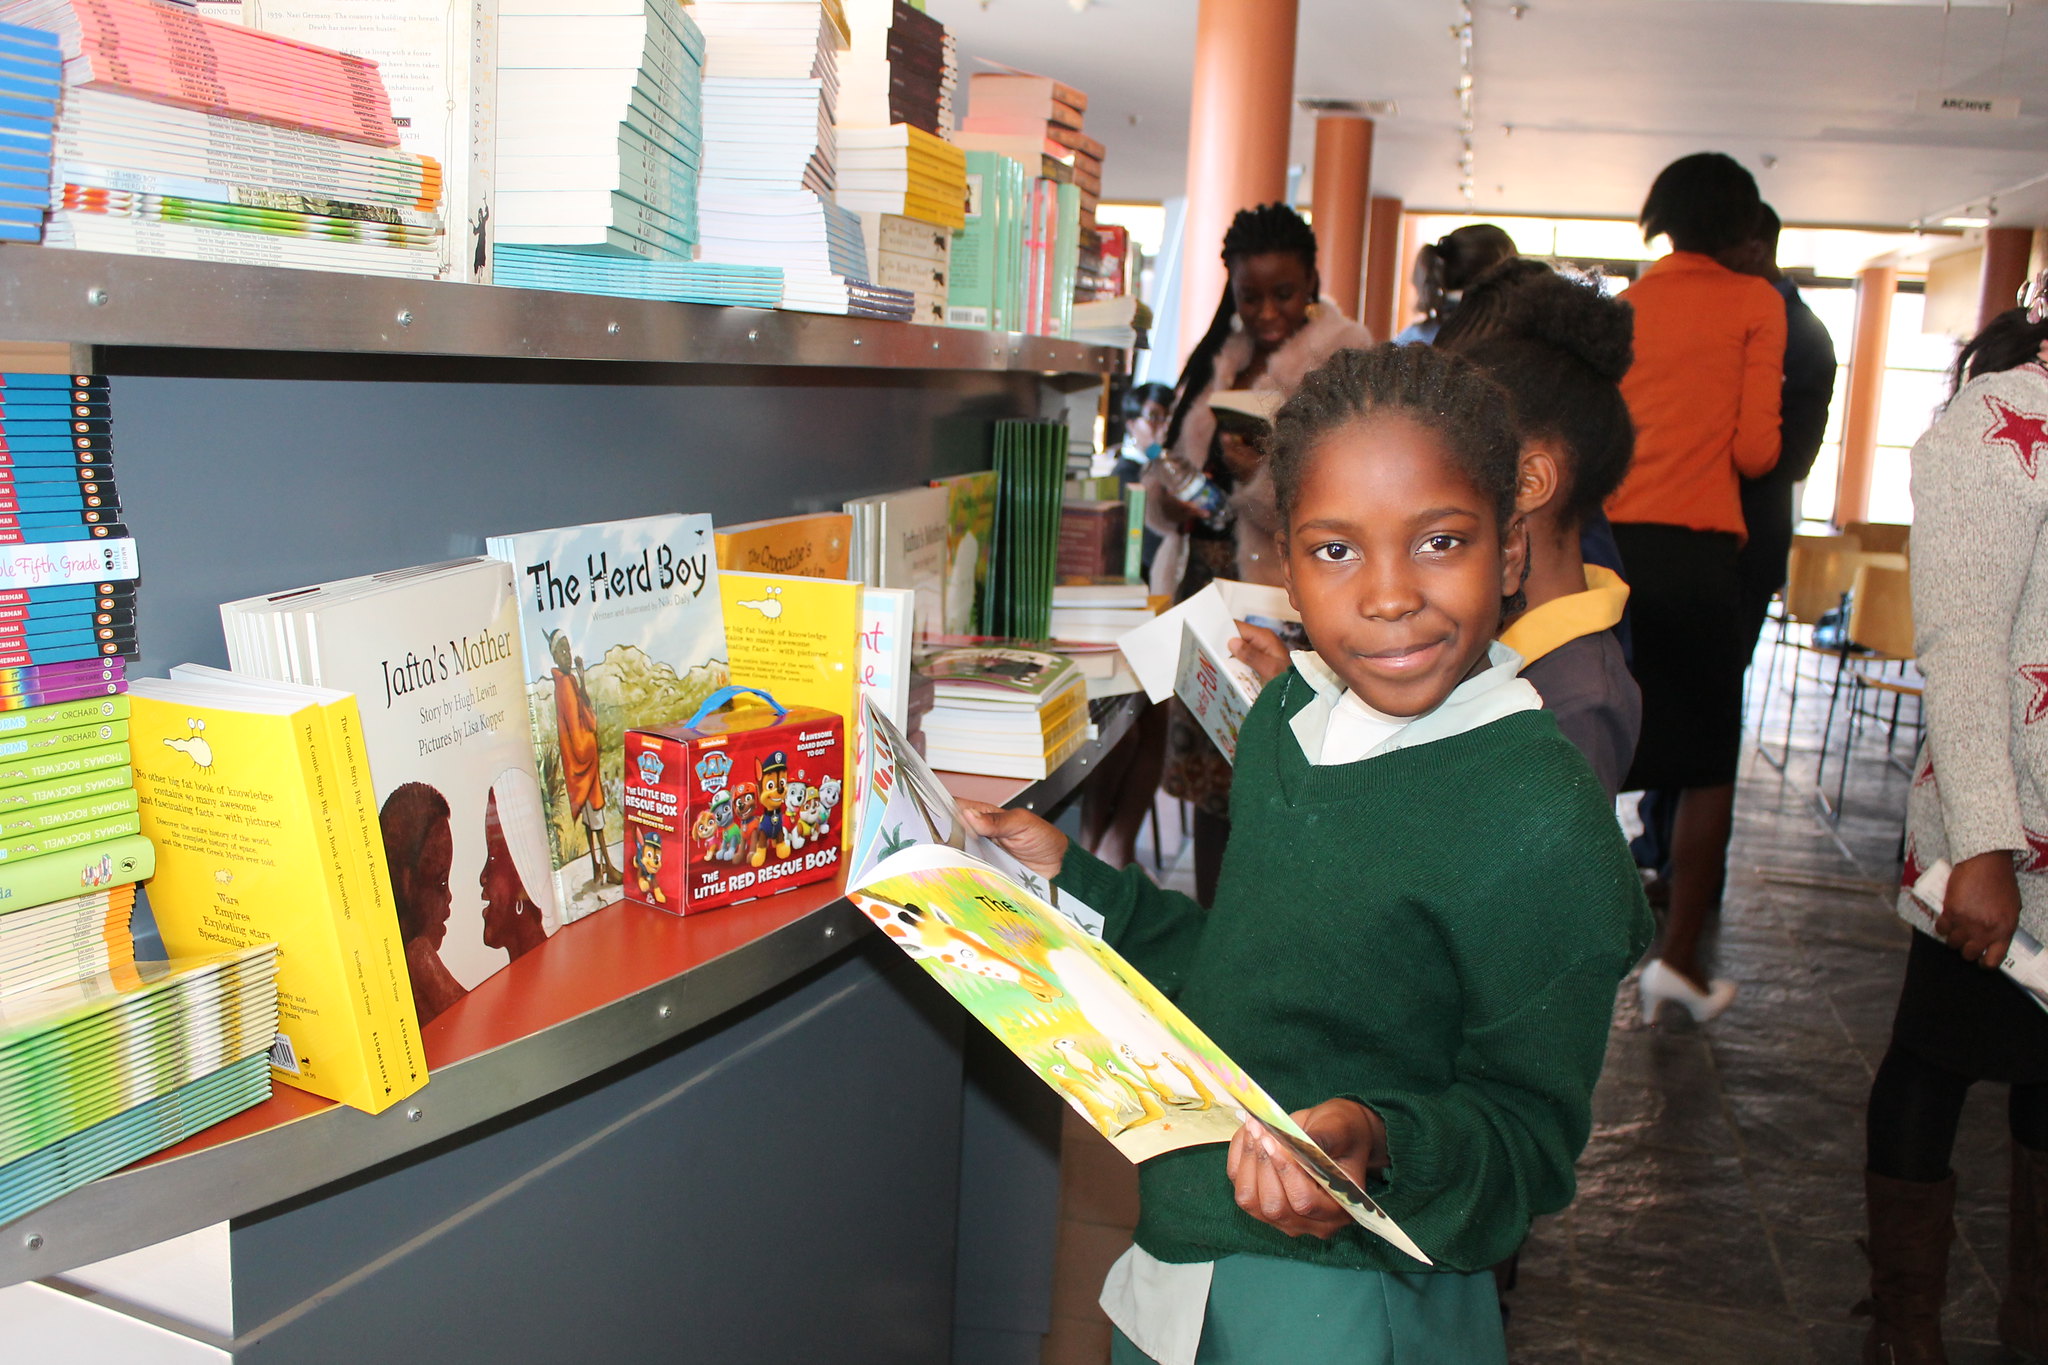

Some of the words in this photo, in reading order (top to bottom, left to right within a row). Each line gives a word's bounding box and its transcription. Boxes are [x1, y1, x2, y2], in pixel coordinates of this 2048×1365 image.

[349, 13, 373, 22] country
[381, 14, 407, 22] holding
[1941, 98, 1992, 112] ARCHIVE
[15, 554, 58, 583] Fifth
[60, 553, 101, 578] Grade
[526, 559, 581, 612] The
[587, 548, 652, 603] Herd
[656, 543, 707, 598] Boy
[788, 630, 827, 640] knowledge
[381, 644, 449, 709] Jafta's
[449, 628, 512, 676] Mother
[62, 707, 99, 719] ORCHARD
[419, 705, 443, 725] Story
[443, 698, 454, 718] by
[454, 689, 476, 712] Hugh
[475, 683, 498, 703] Lewin
[340, 715, 348, 734] The
[418, 733, 453, 757] Pictures
[452, 726, 464, 746] by
[464, 714, 480, 738] Lisa
[479, 709, 505, 733] Kopper
[62, 731, 97, 743] ORCHARD
[797, 743, 816, 751] BOARD
[816, 739, 835, 748] BOOKS
[799, 732, 806, 742] 4
[806, 731, 833, 741] AWESOME
[344, 735, 354, 763] Comic
[32, 760, 81, 776] ROCKWELL
[84, 752, 124, 767] THOMAS
[637, 754, 665, 776] PAW
[695, 757, 734, 781] PAW
[86, 776, 124, 792] THOMAS
[136, 768, 147, 779] No
[148, 772, 166, 784] other
[168, 776, 180, 788] big
[181, 779, 193, 790] fat
[194, 781, 214, 794] book
[216, 786, 225, 796] of
[227, 786, 274, 804] knowledge
[350, 766, 358, 788] Strip
[704, 778, 725, 787] PATROL
[32, 784, 82, 801] ROCKWELL
[153, 787, 184, 799] contains
[196, 796, 217, 808] many
[220, 800, 257, 813] awesome
[626, 786, 636, 795] THE
[637, 787, 659, 800] LITTLE
[660, 792, 677, 804] RED
[92, 800, 131, 815] THOMAS
[140, 796, 154, 806] and
[154, 797, 194, 816] fascinating
[195, 806, 214, 818] facts
[224, 813, 243, 824] with
[244, 815, 282, 829] pictures!
[357, 805, 366, 823] Fat
[625, 795, 655, 812] RESCUE
[656, 802, 678, 816] BOX
[39, 808, 88, 826] ROCKWELL
[305, 724, 313, 743] The
[309, 743, 319, 772] Comic
[316, 776, 324, 799] Strip
[324, 817, 333, 834] Fat
[329, 835, 338, 860] Book
[334, 861, 340, 871] of
[337, 873, 352, 921] Knowledge
[95, 822, 133, 838] THOMAS
[155, 816, 179, 829] Discover
[180, 822, 190, 830] the
[191, 826, 208, 835] entire
[209, 828, 231, 841] history
[231, 833, 238, 841] of
[239, 834, 249, 843] the
[361, 823, 370, 849] Book
[43, 831, 91, 849] ROCKWELL
[171, 830, 181, 838] the
[181, 832, 207, 845] complete
[208, 838, 230, 850] history
[161, 838, 172, 846] and
[172, 840, 182, 848] the
[206, 847, 224, 858] Greek
[225, 851, 245, 864] Myths
[245, 856, 259, 865] ever
[366, 850, 373, 860] of
[694, 881, 726, 900] LITTLE
[728, 871, 756, 892] RED
[758, 857, 803, 883] RESCUE
[805, 846, 837, 870] BOX
[702, 871, 719, 883] THE
[368, 861, 382, 910] Knowledge
[216, 892, 240, 906] Wars
[974, 894, 1018, 913] The
[213, 905, 251, 922] Empires
[197, 927, 246, 948] Spectacular
[202, 915, 247, 938] Exploding
[249, 929, 272, 941] stars
[392, 980, 400, 1003] Turner
[363, 994, 372, 1016] Turner
[399, 1018, 414, 1070] BLOOMSBURY
[372, 1032, 388, 1084] BLOOMSBURY
